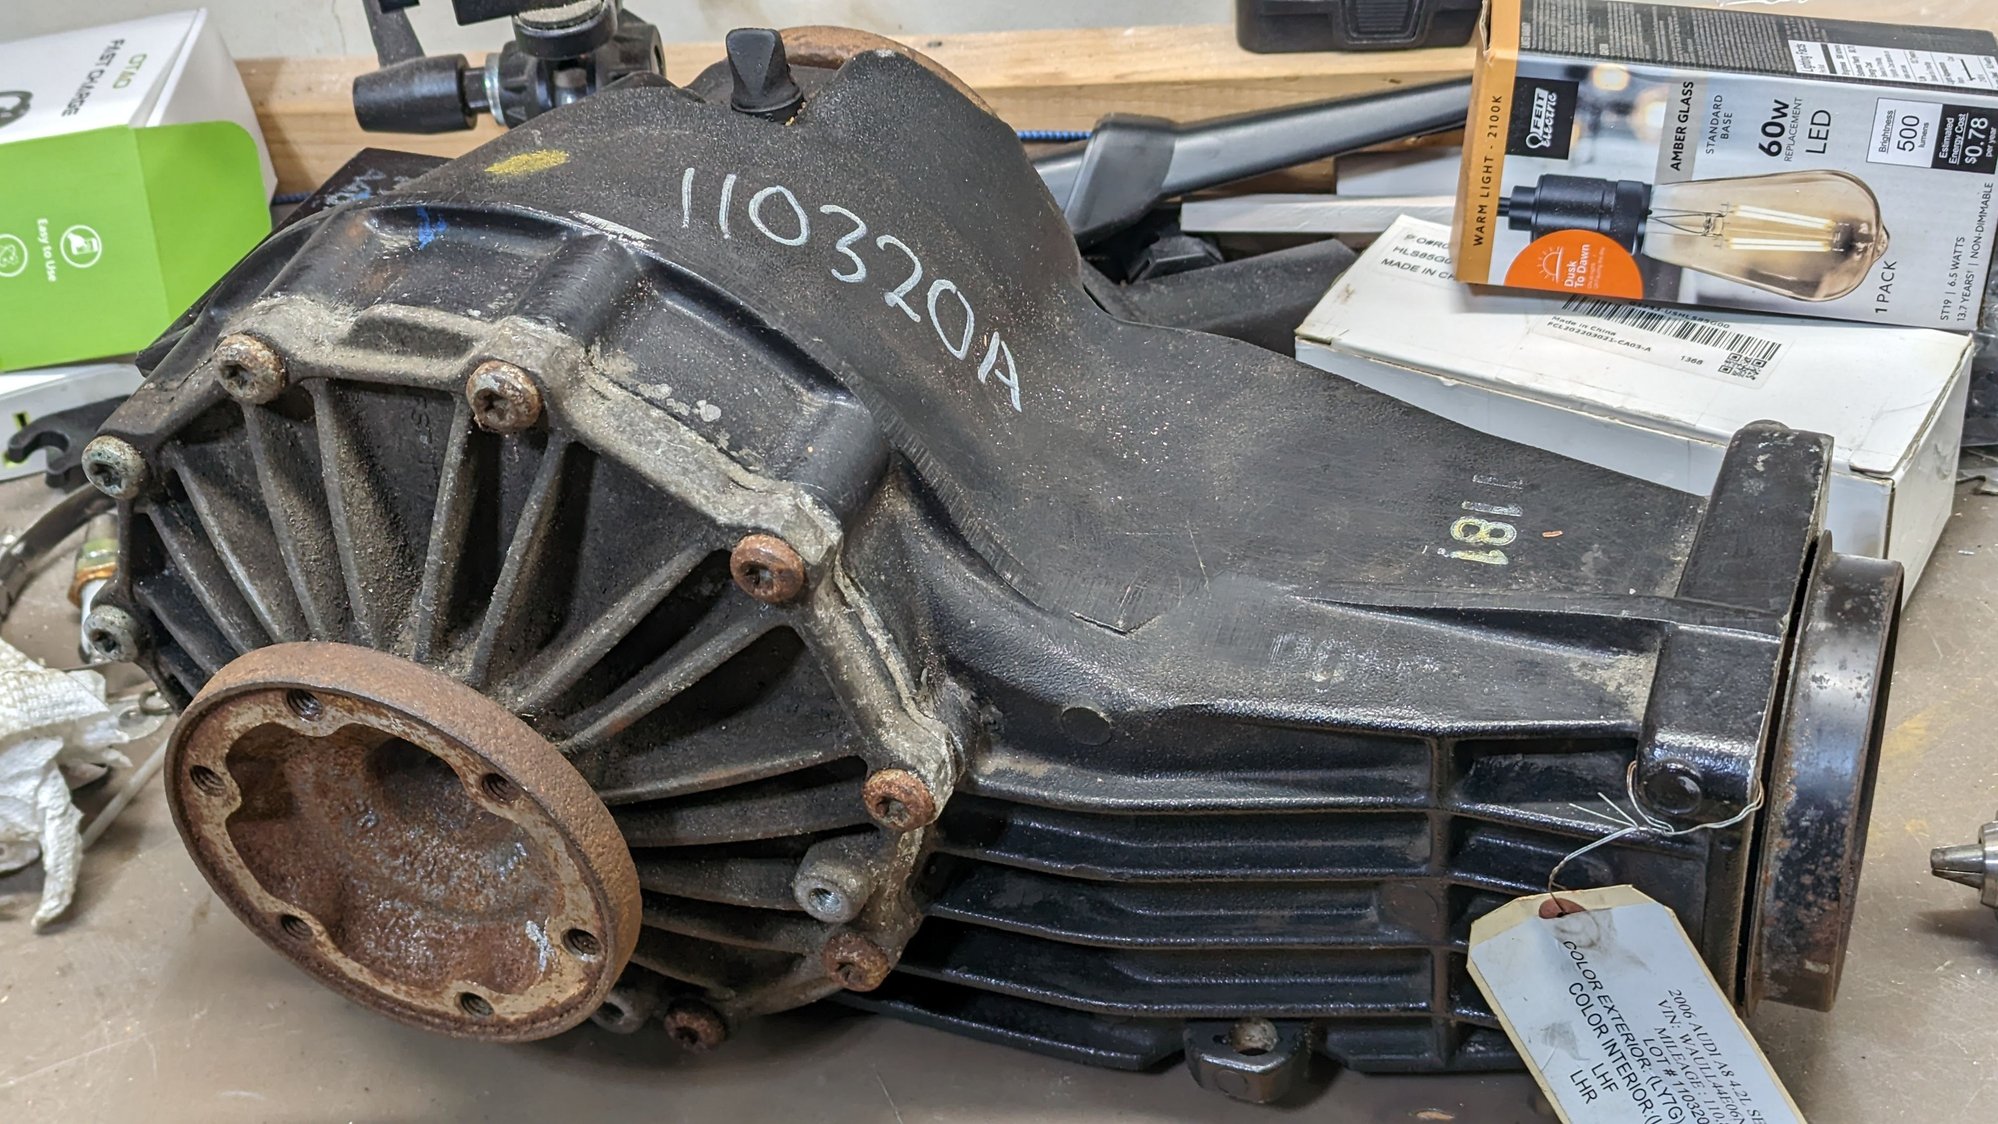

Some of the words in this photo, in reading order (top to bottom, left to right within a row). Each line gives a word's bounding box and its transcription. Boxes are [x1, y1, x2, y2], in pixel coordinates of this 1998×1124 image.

[95, 39, 125, 66] FAST
[61, 69, 105, 117] CHARGE
[1533, 92, 1545, 130] FEIT
[1678, 81, 1694, 123] GLASS
[1487, 95, 1502, 138] 2100K
[1706, 95, 1723, 154] STANDARD
[1720, 112, 1733, 140] BASE
[1784, 97, 1803, 162] REPLACEMENT
[1805, 109, 1832, 154] LED
[1878, 110, 1894, 153] Brightness
[1896, 115, 1920, 152] 500
[1918, 122, 1930, 148] lumens
[1988, 127, 1997, 144] year
[1670, 126, 1687, 171] AMBER
[1939, 117, 1954, 158] Estimated
[1948, 134, 1962, 165] Energy
[1955, 113, 1967, 134] Cost
[1964, 117, 1988, 165] $0.78
[1986, 144, 1995, 157] per
[1480, 157, 1494, 198] LIGHT
[37, 218, 49, 244] Easy
[1473, 204, 1488, 246] WARM
[43, 245, 52, 259] to
[45, 260, 57, 282] Use
[1381, 258, 1420, 273] MADE
[1421, 267, 1437, 276] IN
[1577, 244, 1590, 273] Dawn
[1950, 236, 1965, 270] WATTS
[1957, 305, 1968, 322] 13.7
[1970, 182, 1994, 259] NON-DIMMABLE
[681, 167, 1022, 413] 110320A
[1564, 260, 1577, 287] Dusk
[1574, 276, 1585, 288] To
[1876, 260, 1898, 303] PACK
[1947, 272, 1958, 287] 6.5
[1552, 316, 1577, 326] Made
[1590, 325, 1617, 336] China
[1940, 299, 1952, 321] ST19
[1563, 941, 1604, 991] COLOR
[1597, 994, 1652, 1074] EXTERIOR:
[1568, 983, 1609, 1039] COLOR
[1658, 999, 1682, 1029] VIN:
[1643, 1038, 1671, 1065] LOT
[1662, 1068, 1678, 1077] #
[1668, 989, 1696, 1018] 2006
[1689, 1022, 1722, 1056] AUDI
[1714, 1060, 1735, 1077] A8
[1730, 1080, 1752, 1106] 4.2L
[1570, 1070, 1598, 1104] LHR
[1591, 1063, 1619, 1093] LHF
[1654, 1027, 1705, 1089] MILEAGE
[1704, 1100, 1729, 1124] 110.
